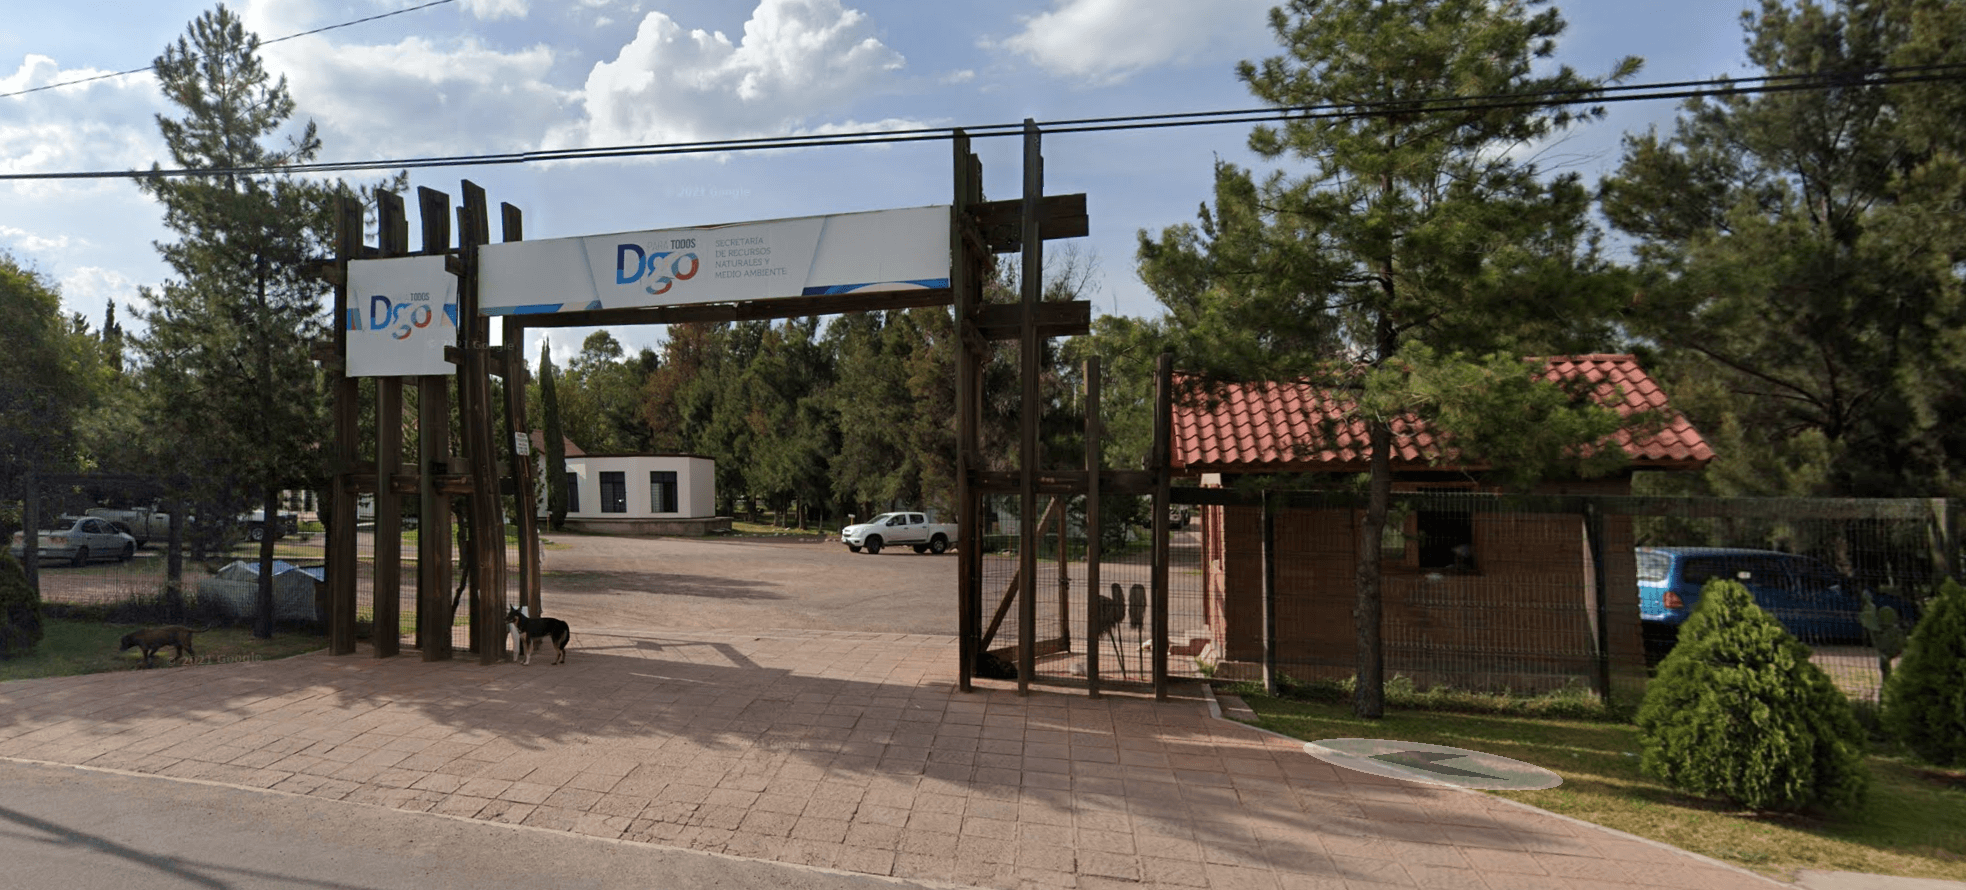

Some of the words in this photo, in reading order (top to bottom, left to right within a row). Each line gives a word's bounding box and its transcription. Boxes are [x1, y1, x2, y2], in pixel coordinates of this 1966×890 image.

[670, 238, 697, 250] TODOS
[715, 237, 765, 248] SECRETARÍA
[715, 250, 727, 258] DE
[728, 247, 772, 258] RECURSOS
[616, 243, 700, 295] Dgo
[715, 258, 763, 269] NATURALES
[764, 257, 770, 266] Y
[714, 270, 742, 279] MEDIO
[743, 267, 788, 278] AMBIENTE
[410, 292, 430, 302] TODOS
[369, 295, 432, 340] Dgo
